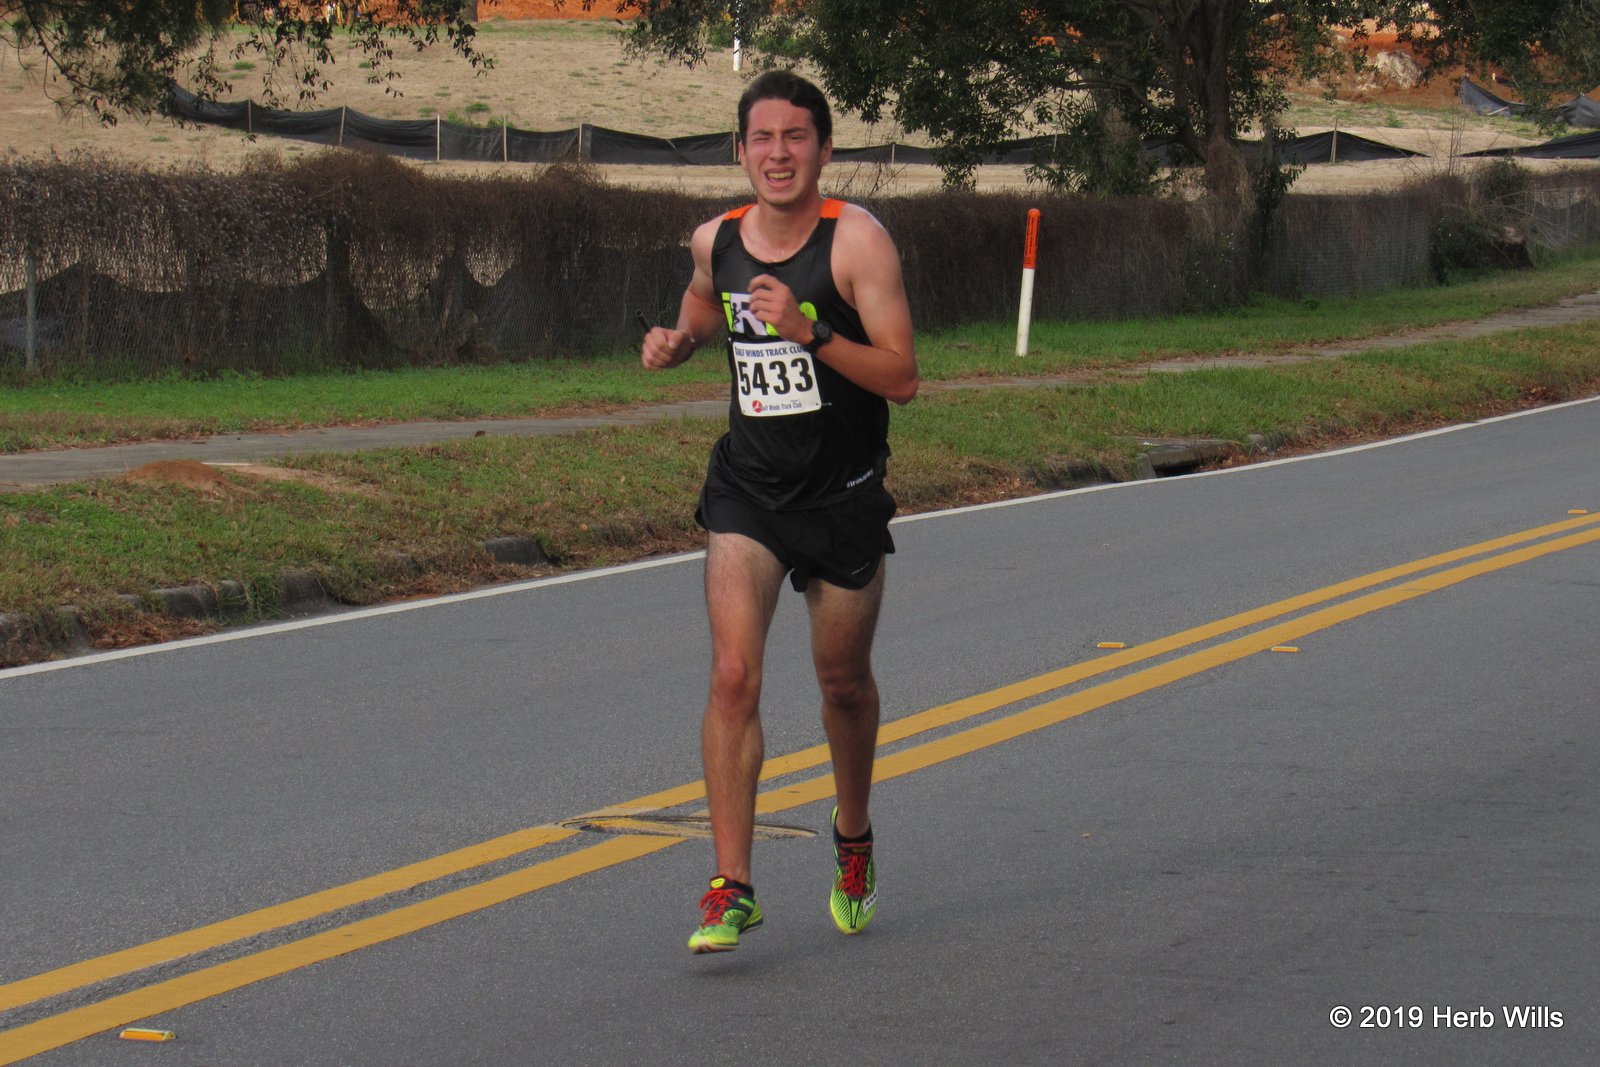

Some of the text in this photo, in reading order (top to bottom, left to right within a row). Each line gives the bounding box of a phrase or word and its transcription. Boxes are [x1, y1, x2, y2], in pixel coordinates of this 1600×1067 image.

[746, 349, 764, 358] WINDS
[765, 347, 788, 357] TRACK
[737, 357, 813, 396] 5433
